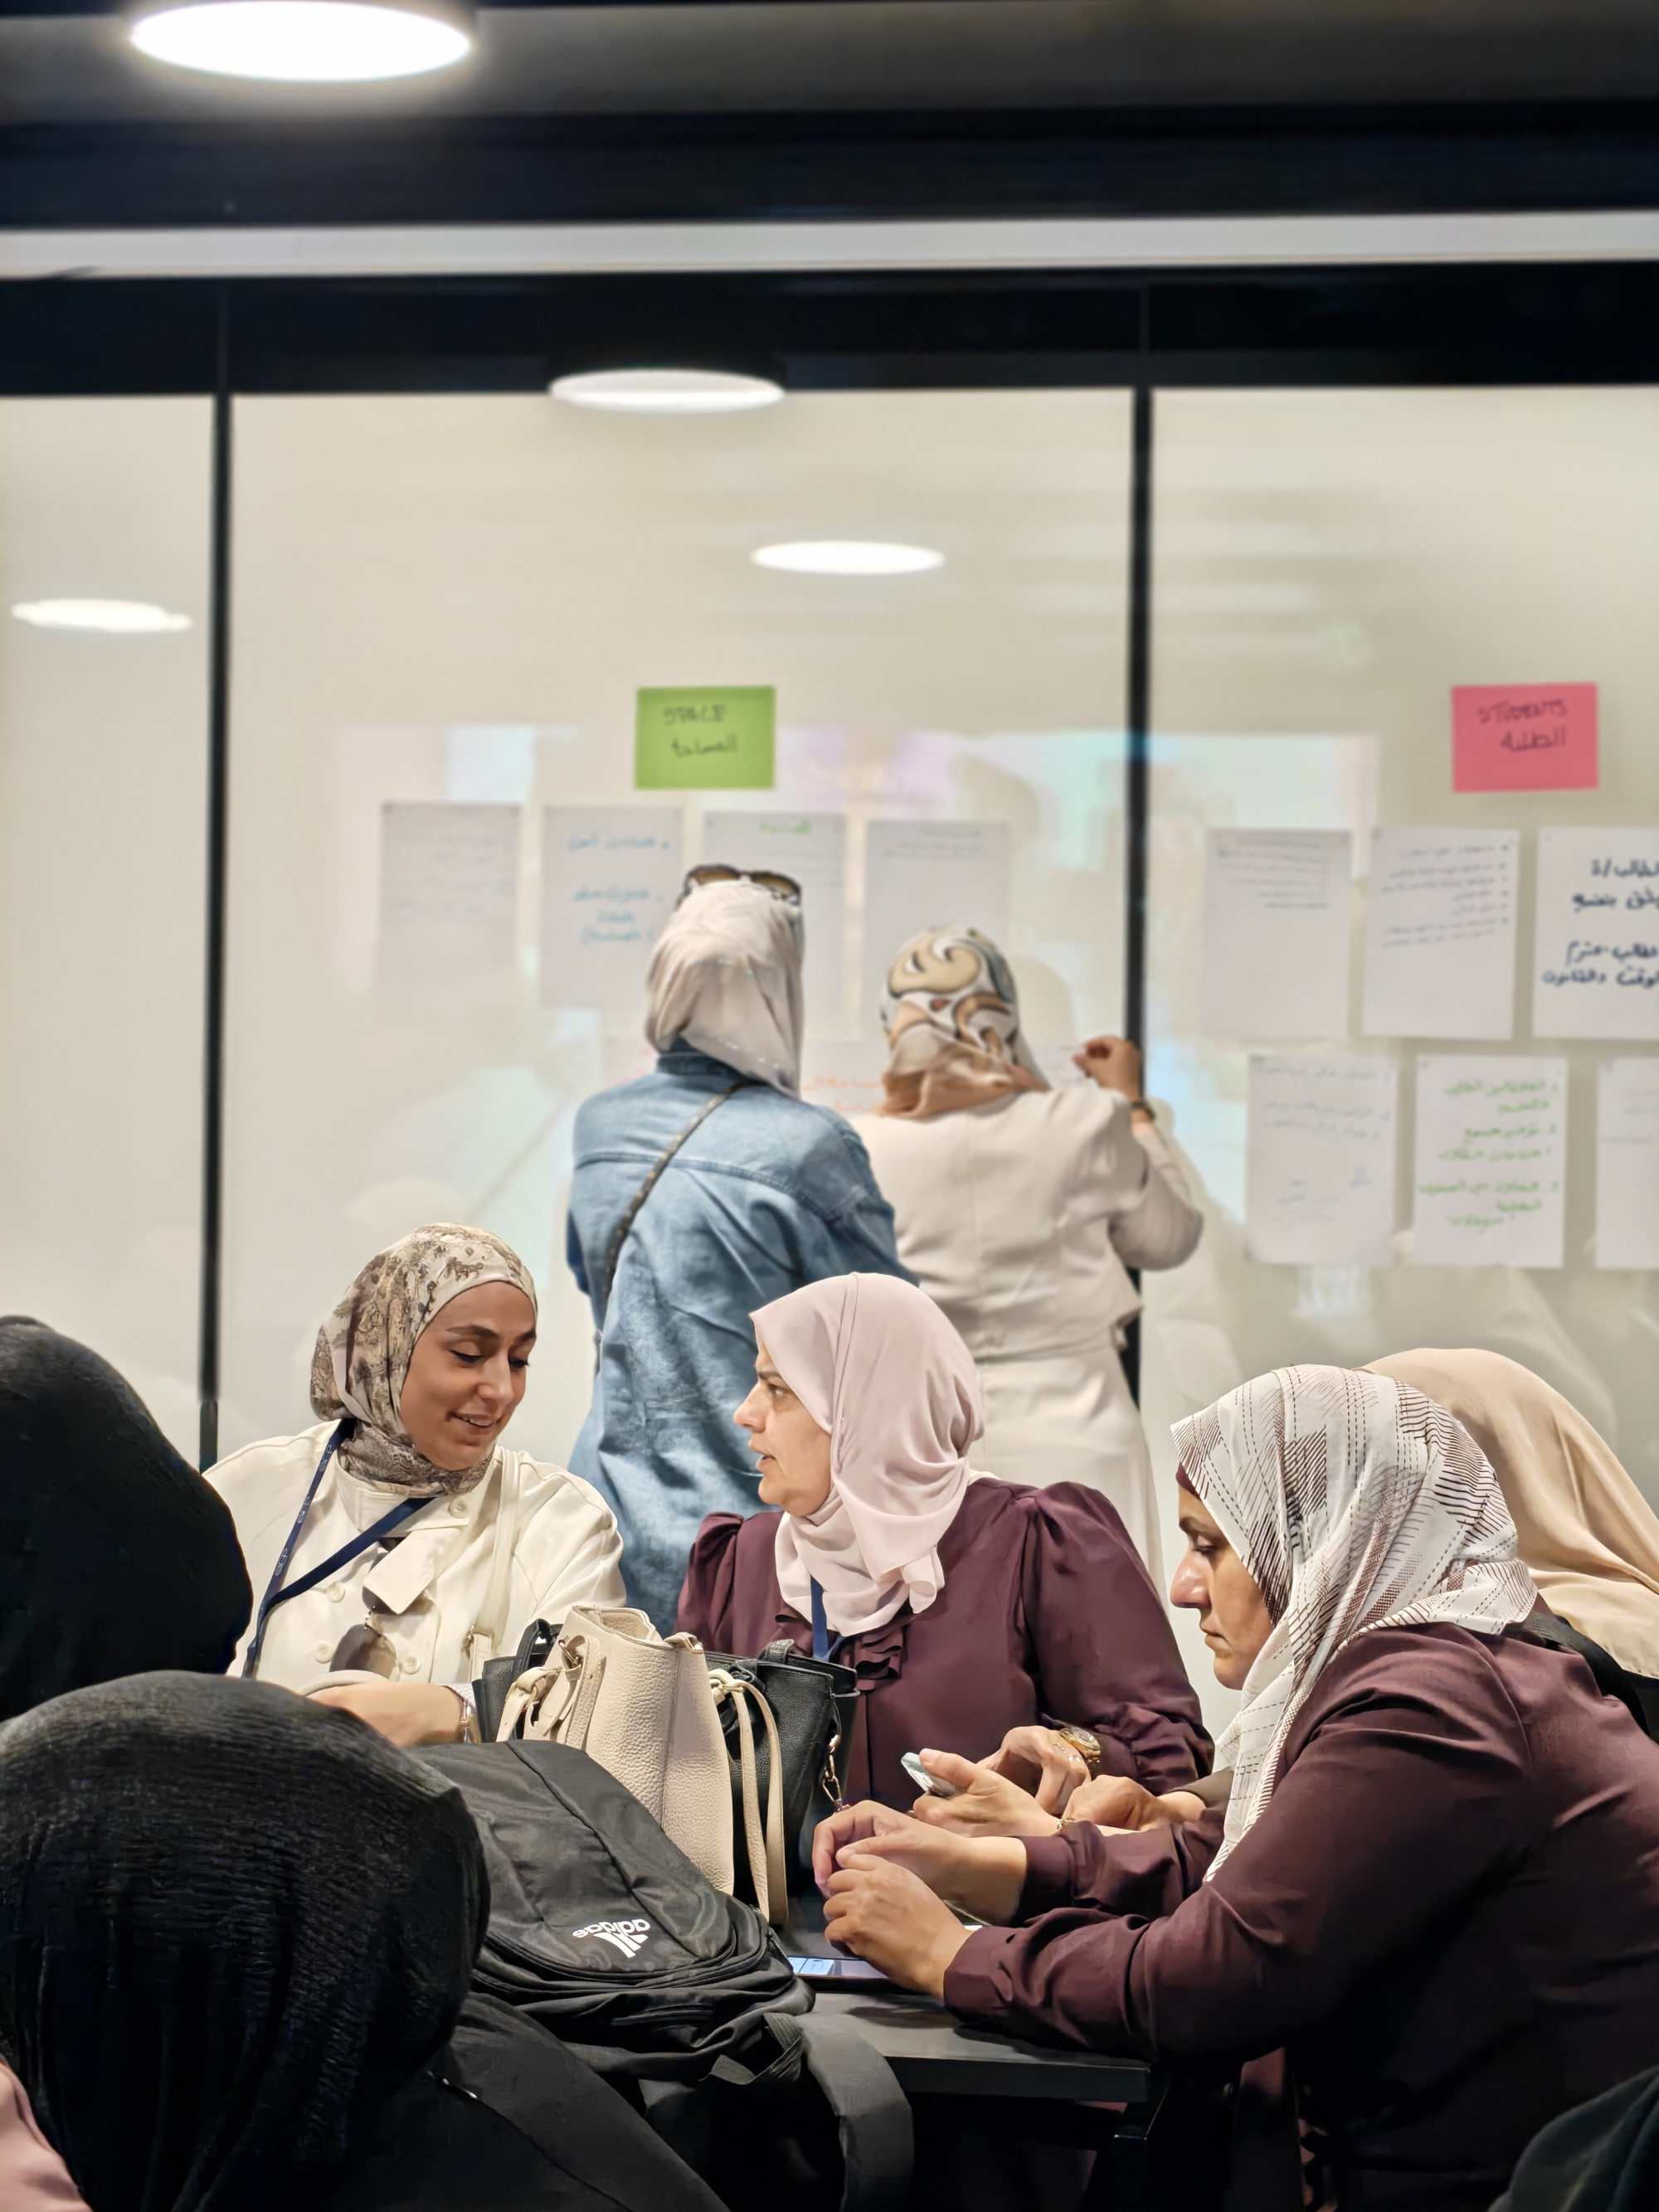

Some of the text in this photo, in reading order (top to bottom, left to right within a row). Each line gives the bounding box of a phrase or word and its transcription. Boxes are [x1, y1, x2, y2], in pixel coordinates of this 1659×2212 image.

[663, 704, 727, 727] SPACE
[1477, 700, 1569, 724] STUDENTS
[572, 1918, 651, 1938] adidas
